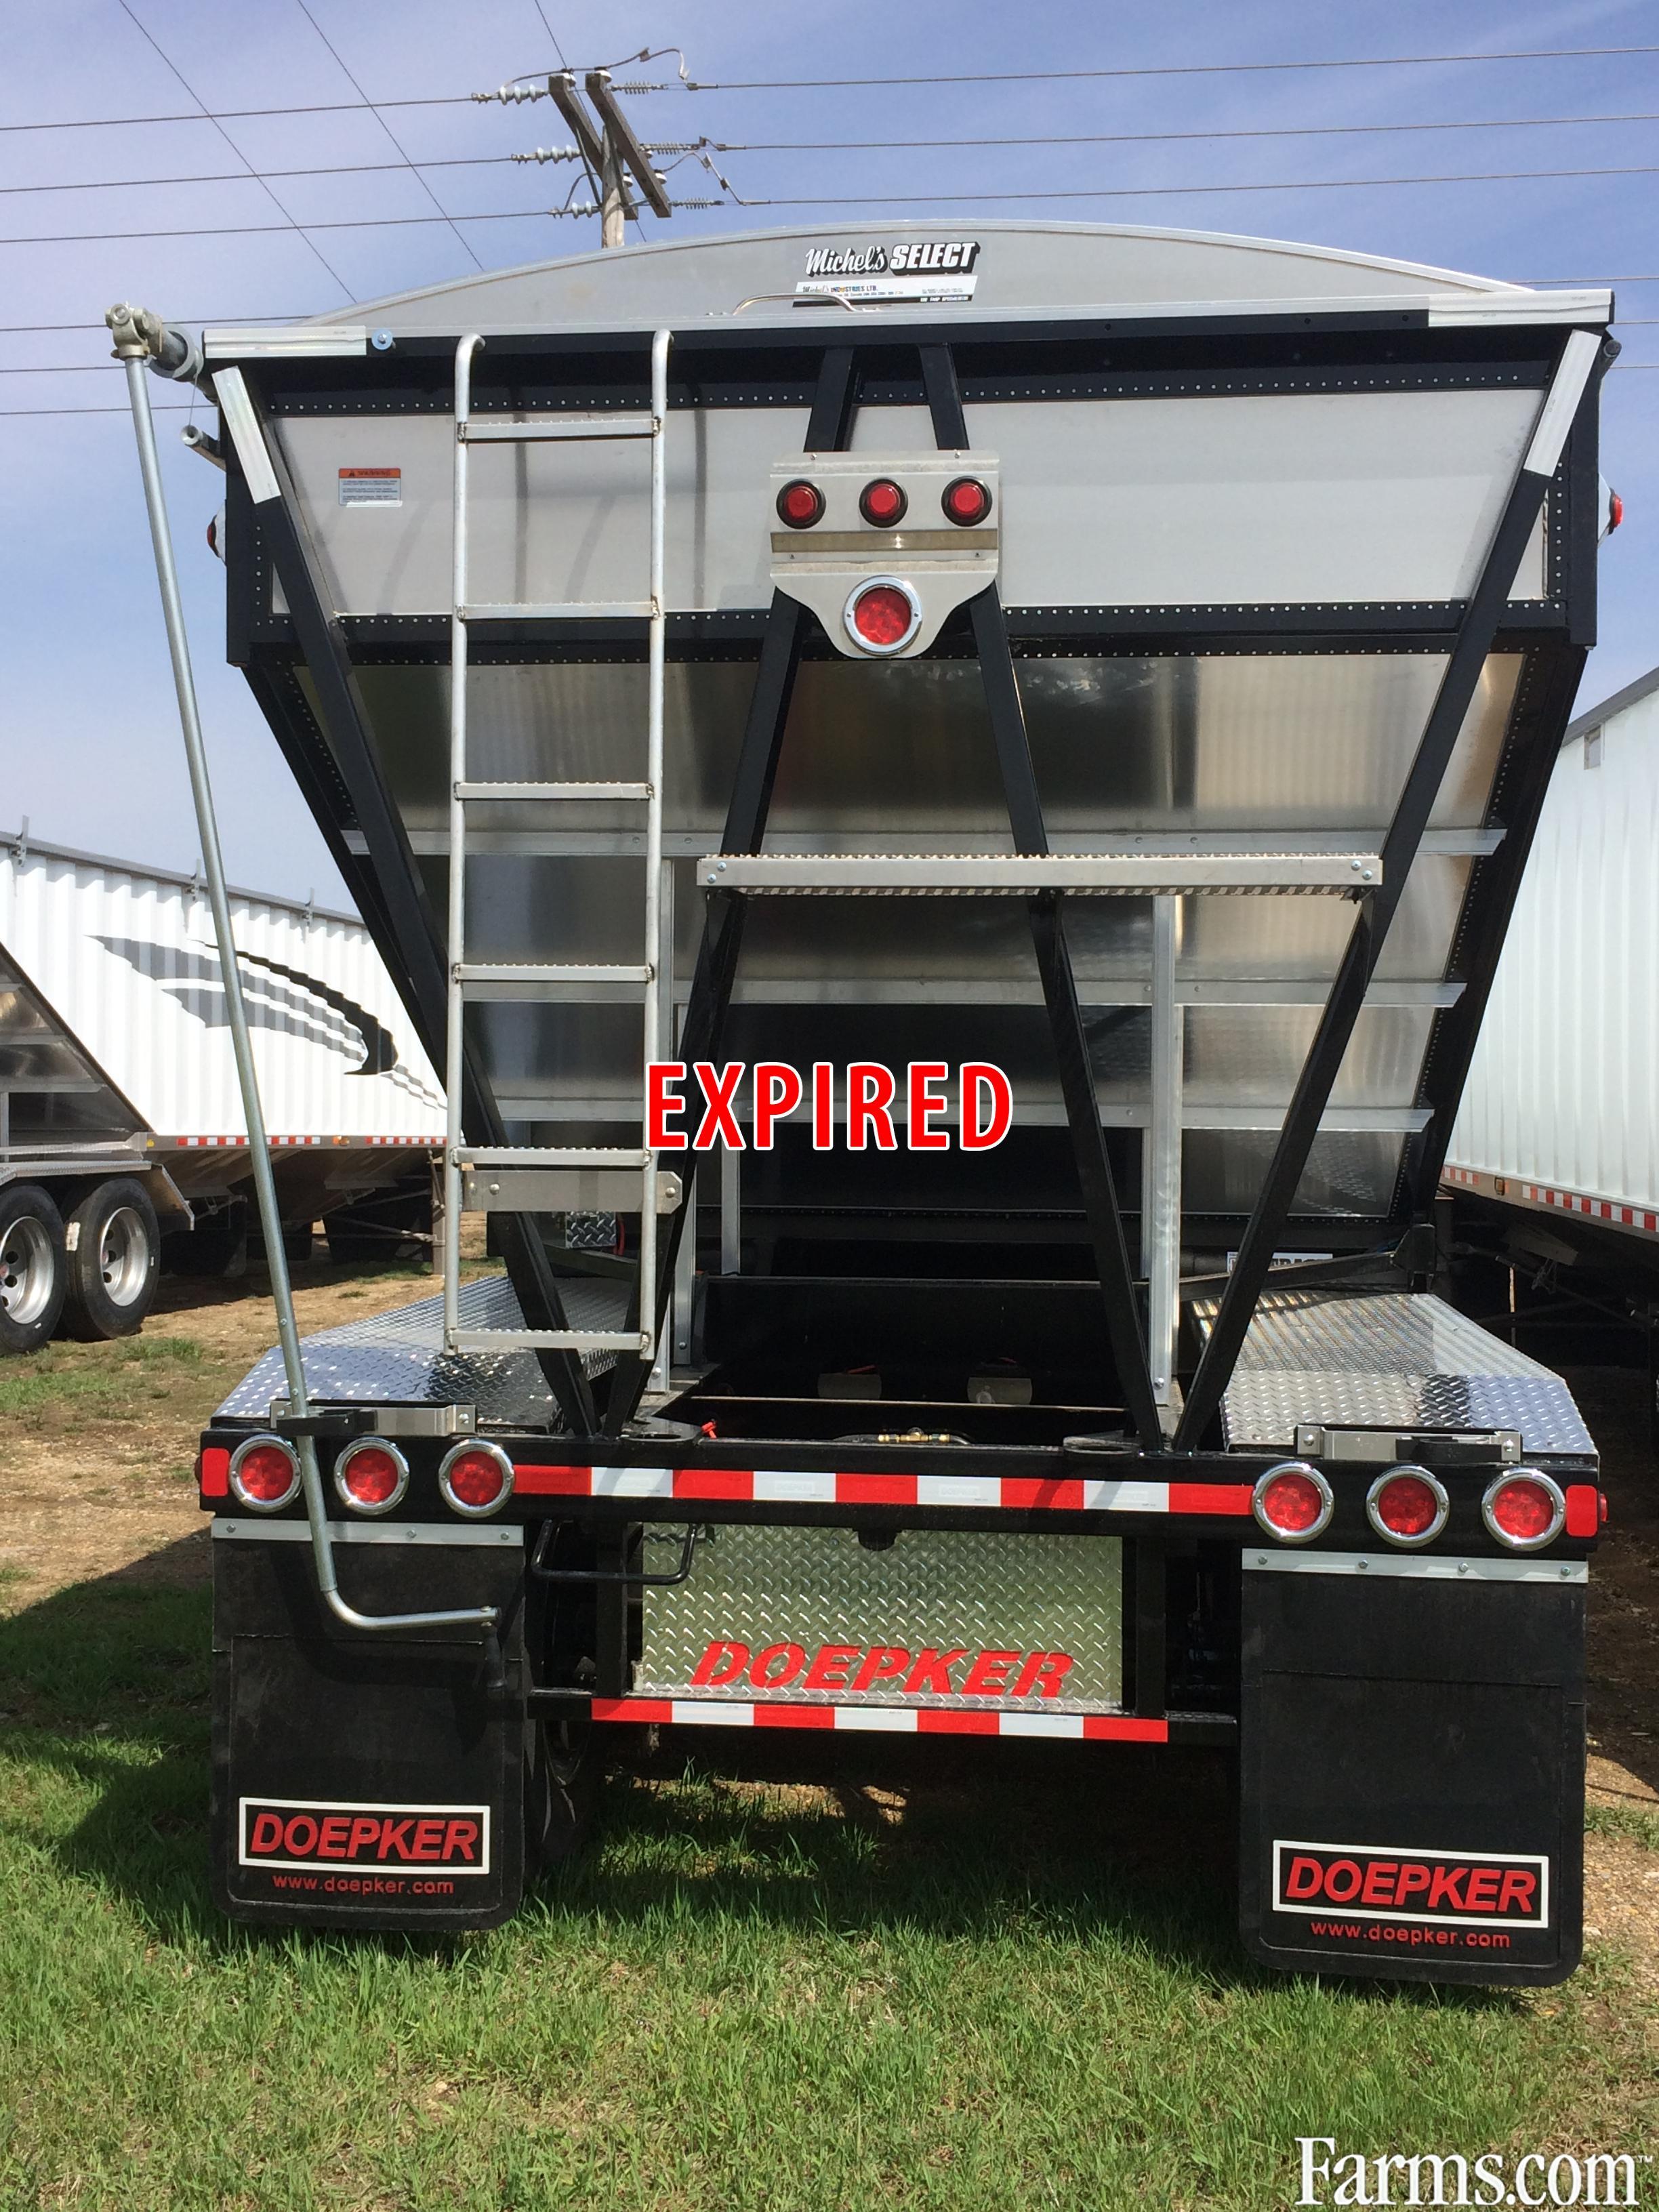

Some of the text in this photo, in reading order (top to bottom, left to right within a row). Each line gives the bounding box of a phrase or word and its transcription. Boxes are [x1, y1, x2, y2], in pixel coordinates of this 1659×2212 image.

[805, 241, 979, 276] Michel's SELECT
[691, 1641, 1073, 1697] DOEPKER
[251, 1813, 478, 1860] DOEPKER
[272, 1875, 454, 1895] www.doepker.com
[1286, 1856, 1536, 1913] DOEPKER
[1311, 1921, 1511, 1948] www.doepker.com
